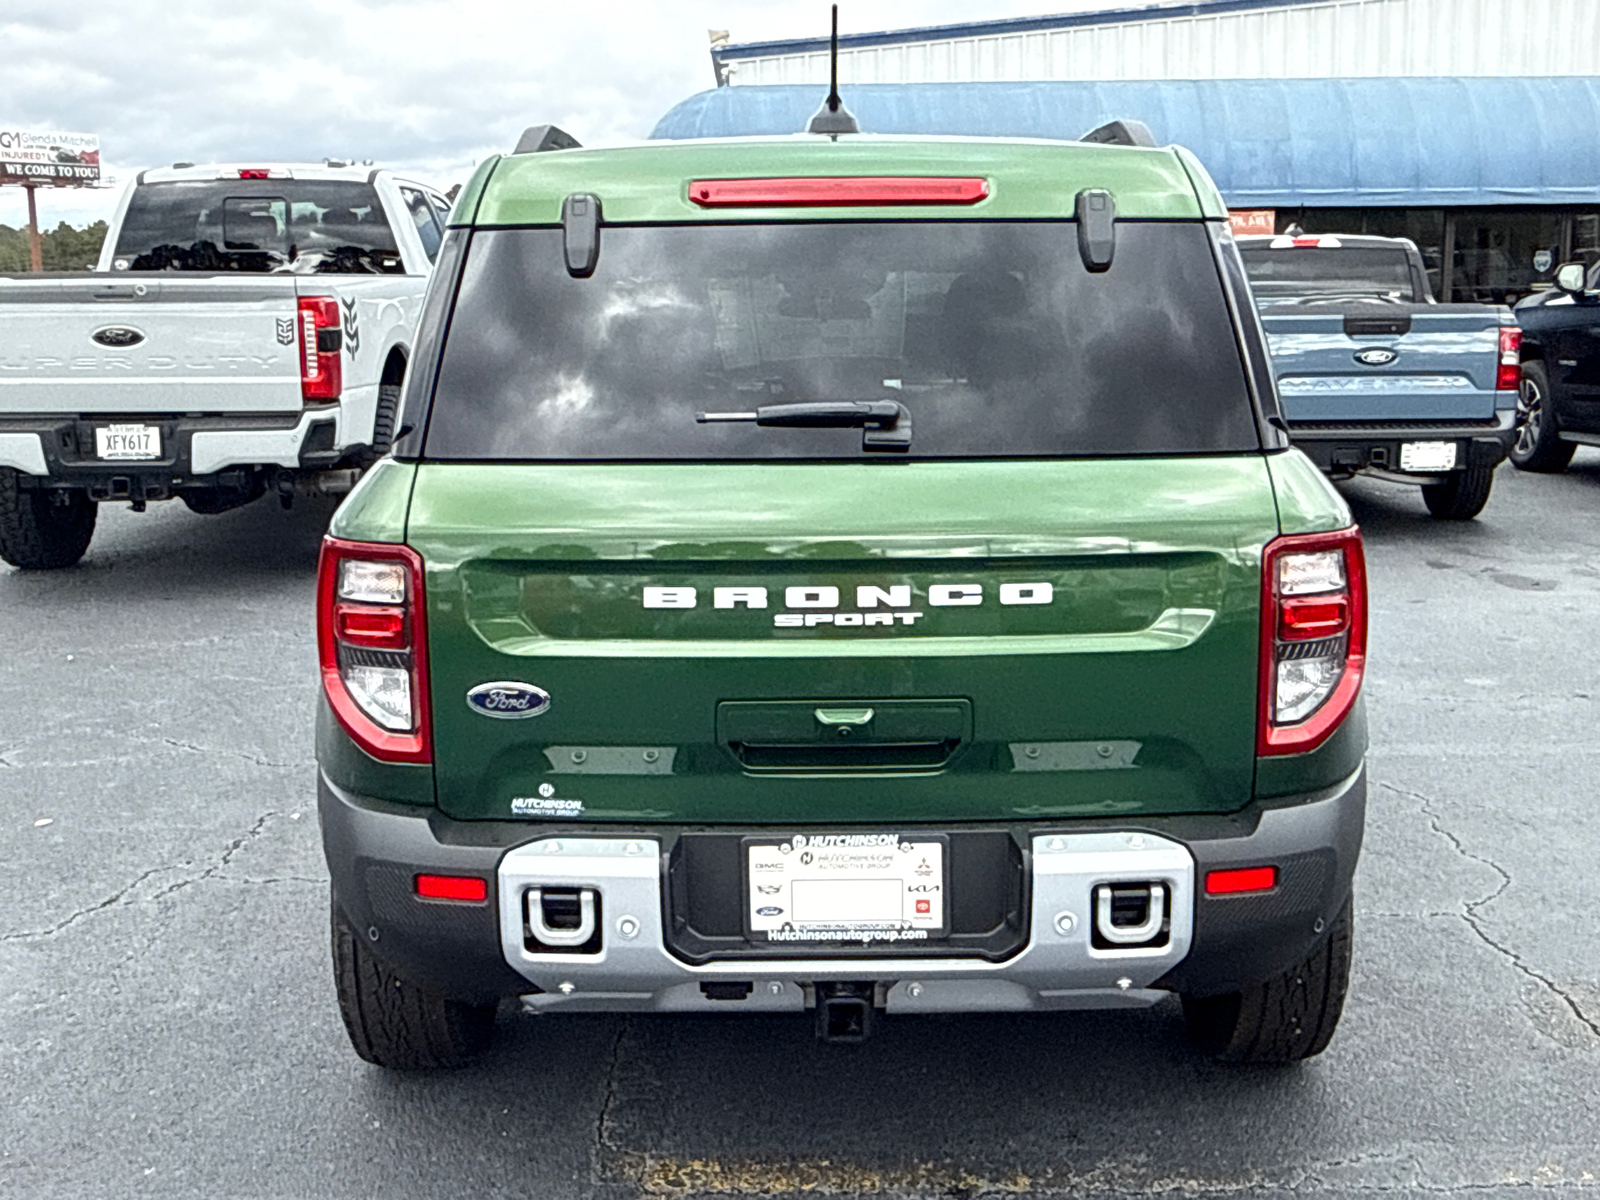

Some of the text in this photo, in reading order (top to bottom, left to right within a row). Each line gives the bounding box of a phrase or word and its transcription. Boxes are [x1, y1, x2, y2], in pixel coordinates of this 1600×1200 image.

[21, 132, 97, 147] Glenda Mitchell
[1, 151, 46, 160] INJURED?
[5, 164, 99, 178] WE COME TO YOU!
[147, 356, 279, 370] DUTY
[106, 434, 150, 451] XFY617
[643, 582, 1053, 609] BRONCO
[774, 612, 923, 627] SPORT
[485, 689, 531, 709] Ford
[511, 798, 583, 810] HUTCHINSON
[556, 809, 580, 817] GROUP
[809, 834, 899, 848] HUTCHINSON
[768, 930, 928, 942] Hutchinsonautogroup.com
